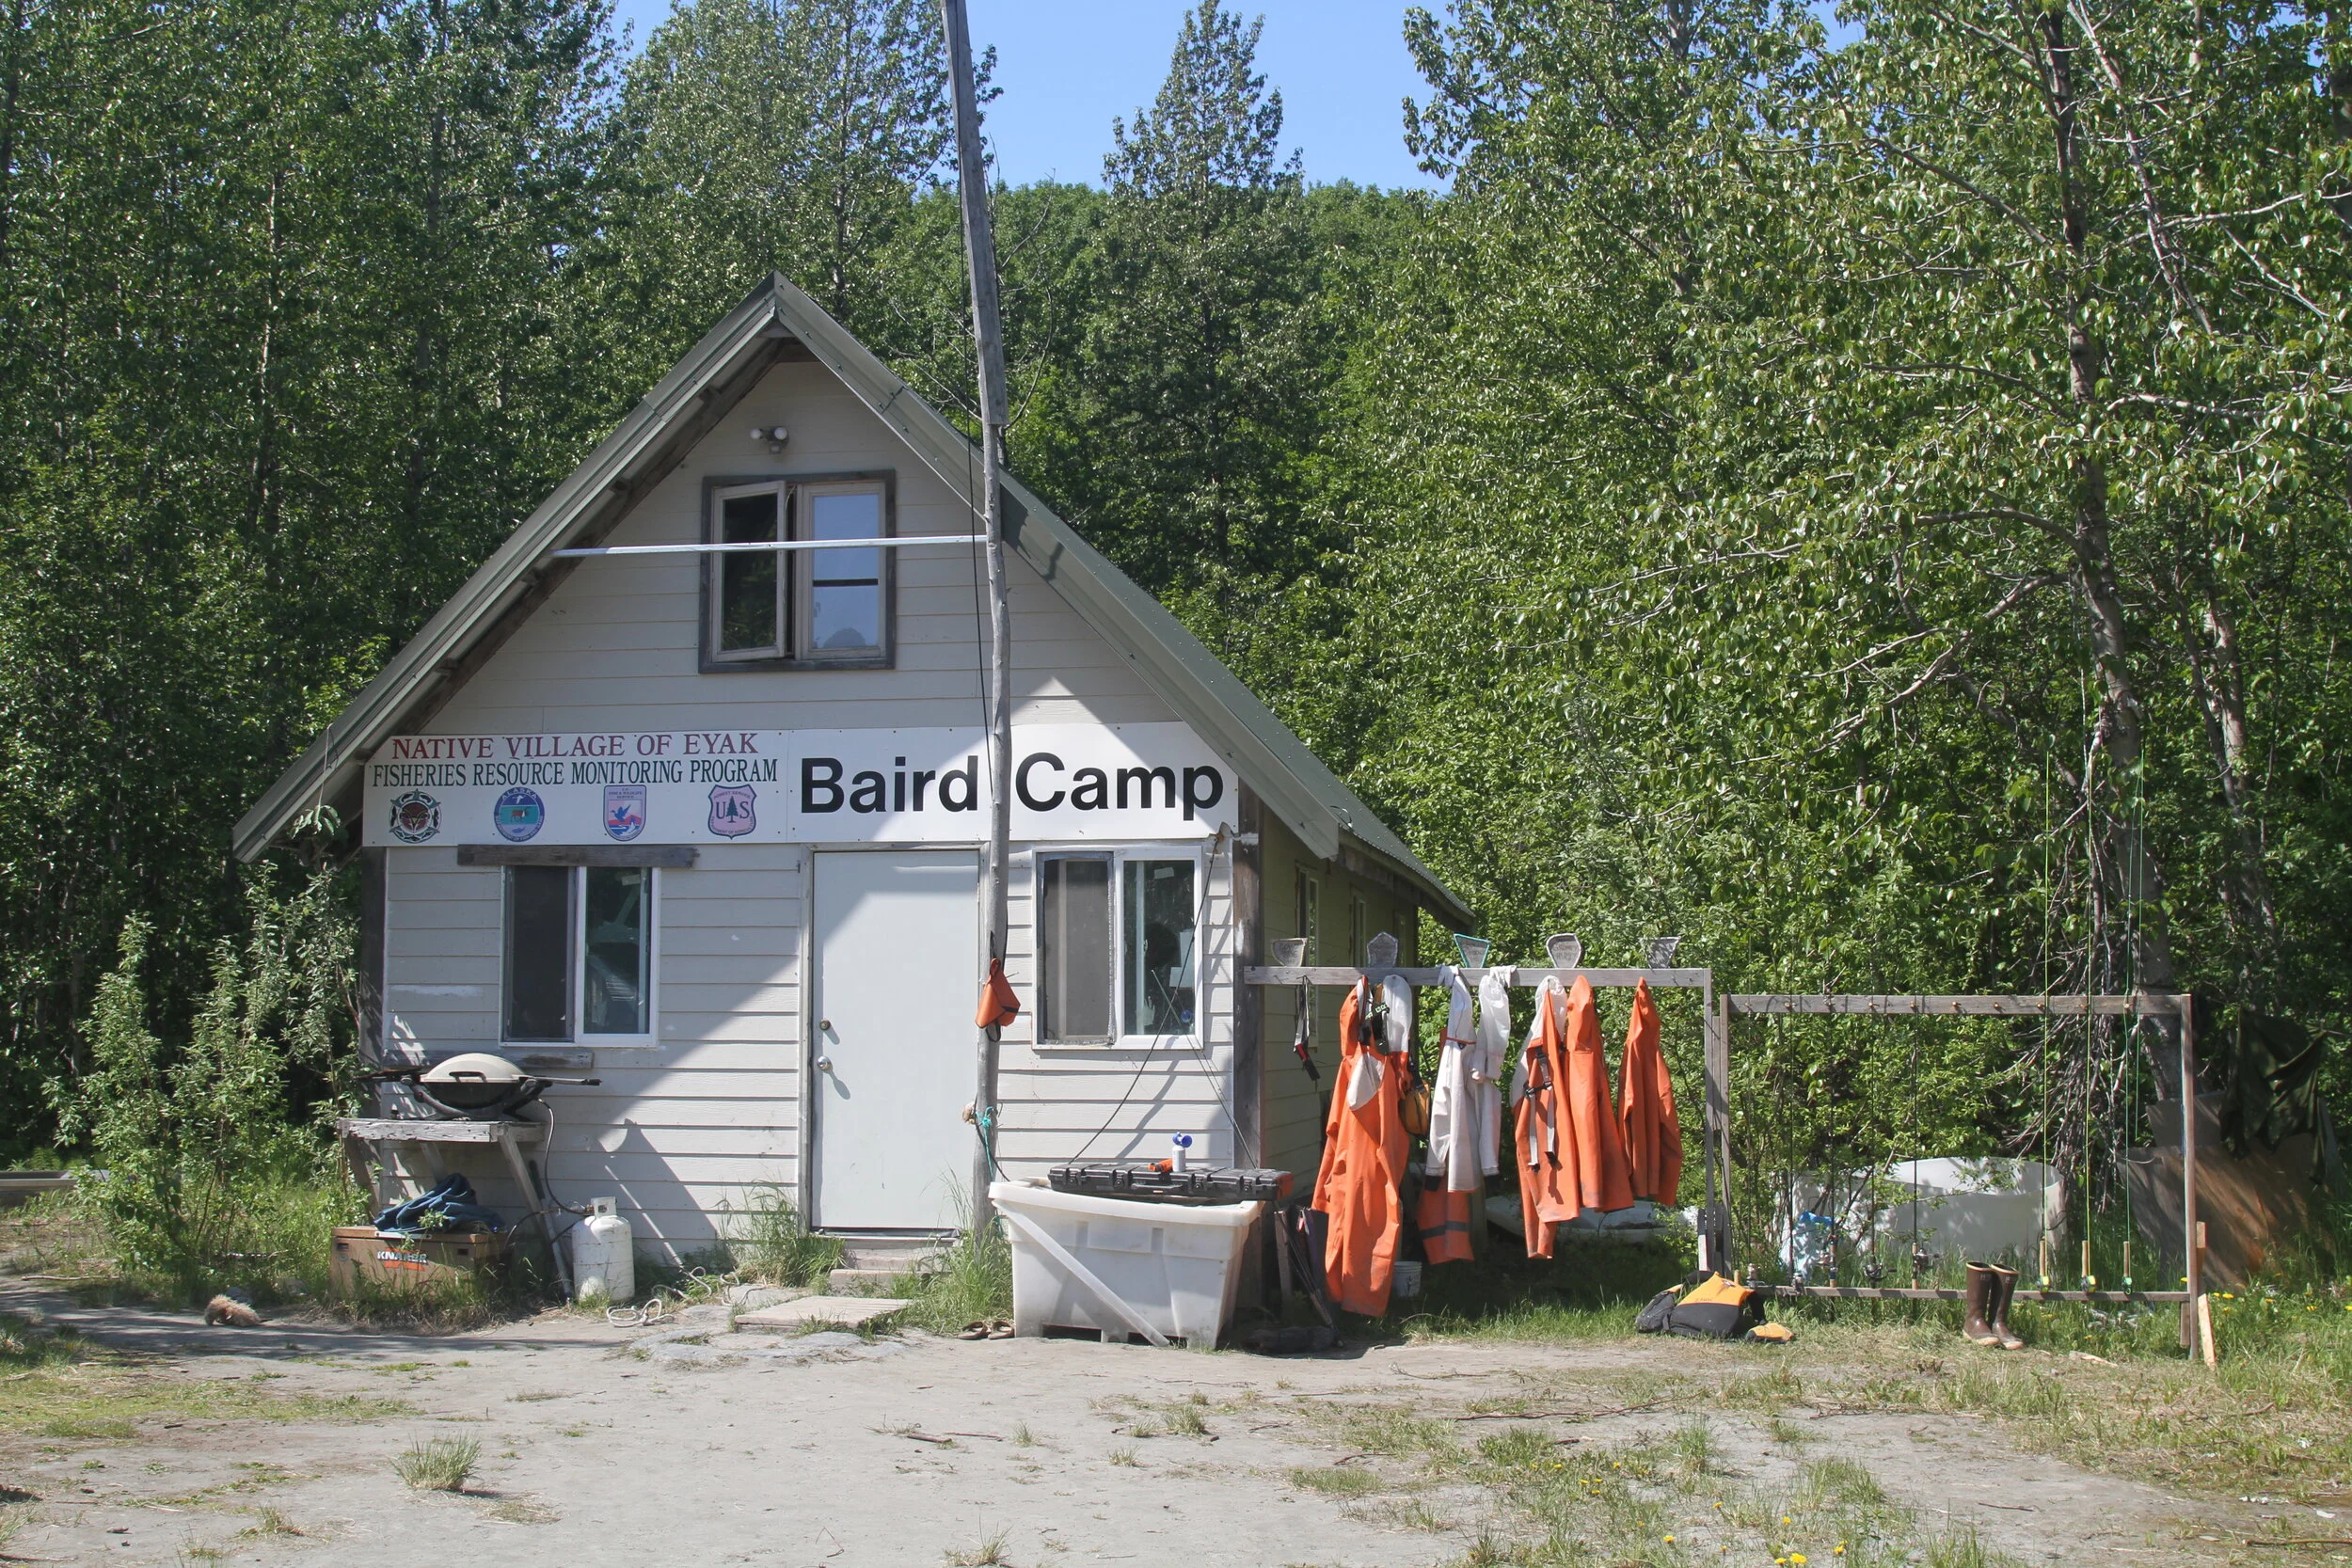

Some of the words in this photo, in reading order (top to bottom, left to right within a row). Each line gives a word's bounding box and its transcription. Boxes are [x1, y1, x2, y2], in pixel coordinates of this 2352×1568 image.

[391, 738, 494, 759] NATIVE
[506, 736, 626, 758] VILLAGE
[637, 735, 672, 755] OF
[684, 733, 758, 754] EYAK
[373, 763, 467, 786] FISHERIES
[473, 762, 564, 785] RESOURCE
[570, 760, 683, 784] MONITORING
[690, 758, 778, 783] PROGRAM
[501, 787, 537, 800] ALASKA
[801, 755, 978, 813] Baird
[1015, 752, 1224, 820] Camp
